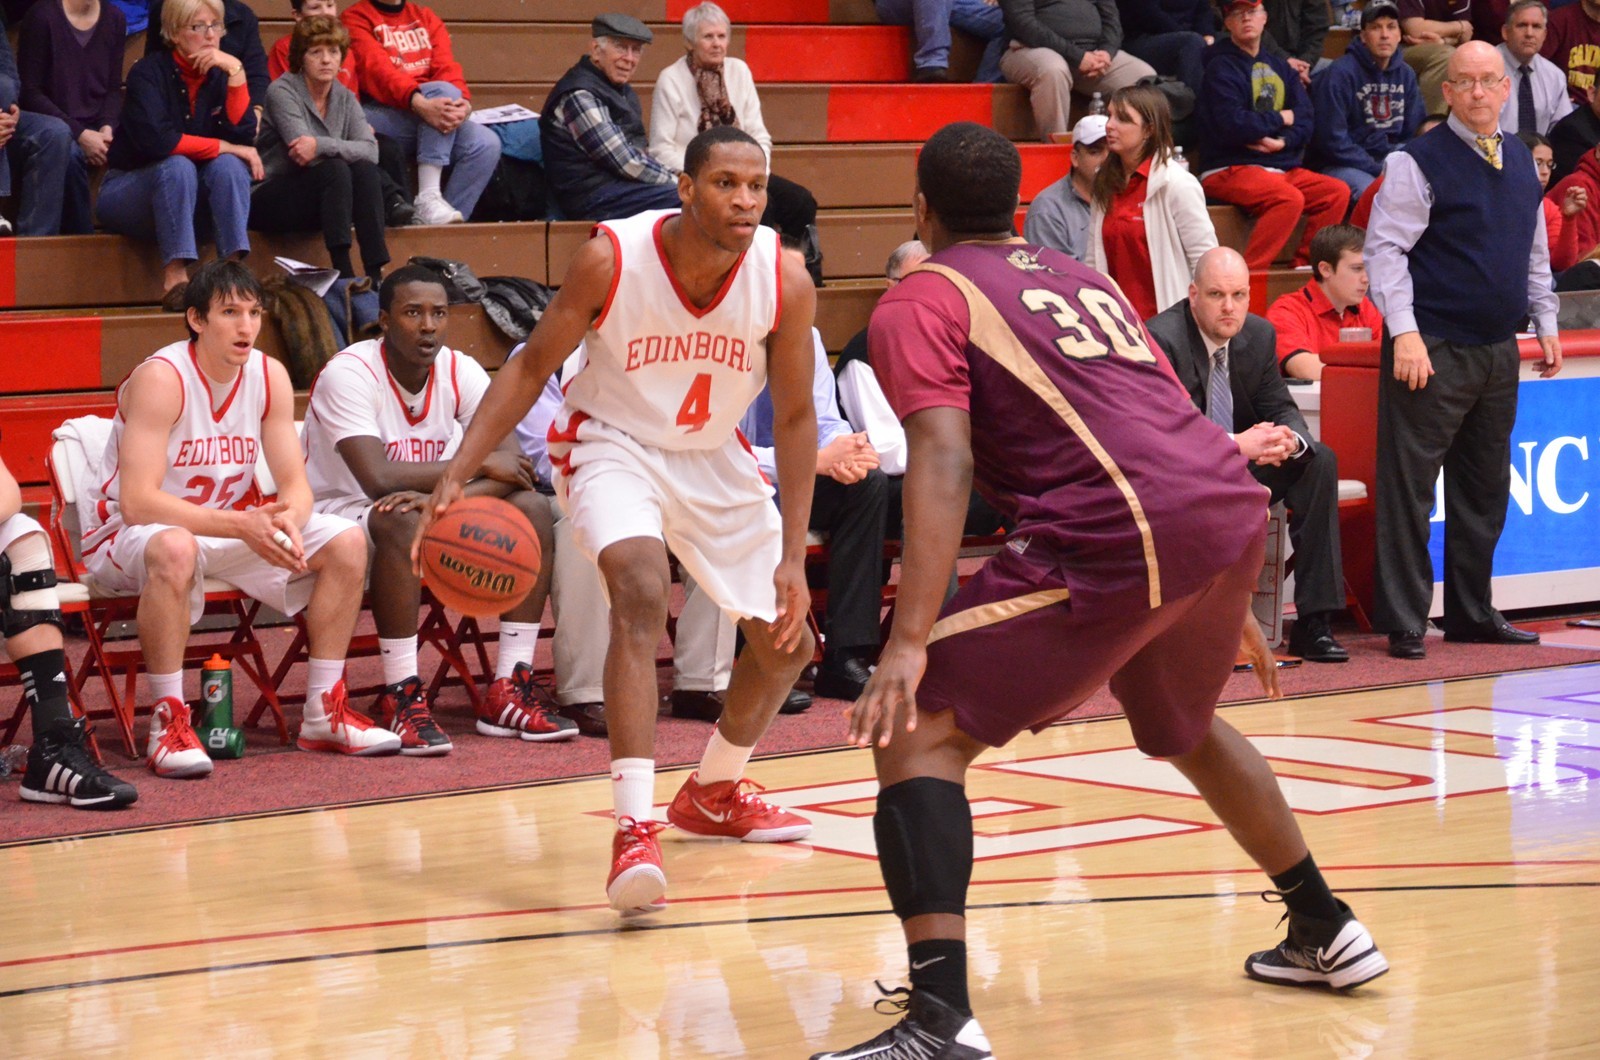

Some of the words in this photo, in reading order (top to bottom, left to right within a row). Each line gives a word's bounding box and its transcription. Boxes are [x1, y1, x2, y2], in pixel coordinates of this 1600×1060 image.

[1018, 287, 1158, 366] 30
[676, 372, 712, 434] 4
[181, 472, 245, 509] 25
[459, 523, 518, 555] NCAA
[440, 551, 516, 595] Wilson
